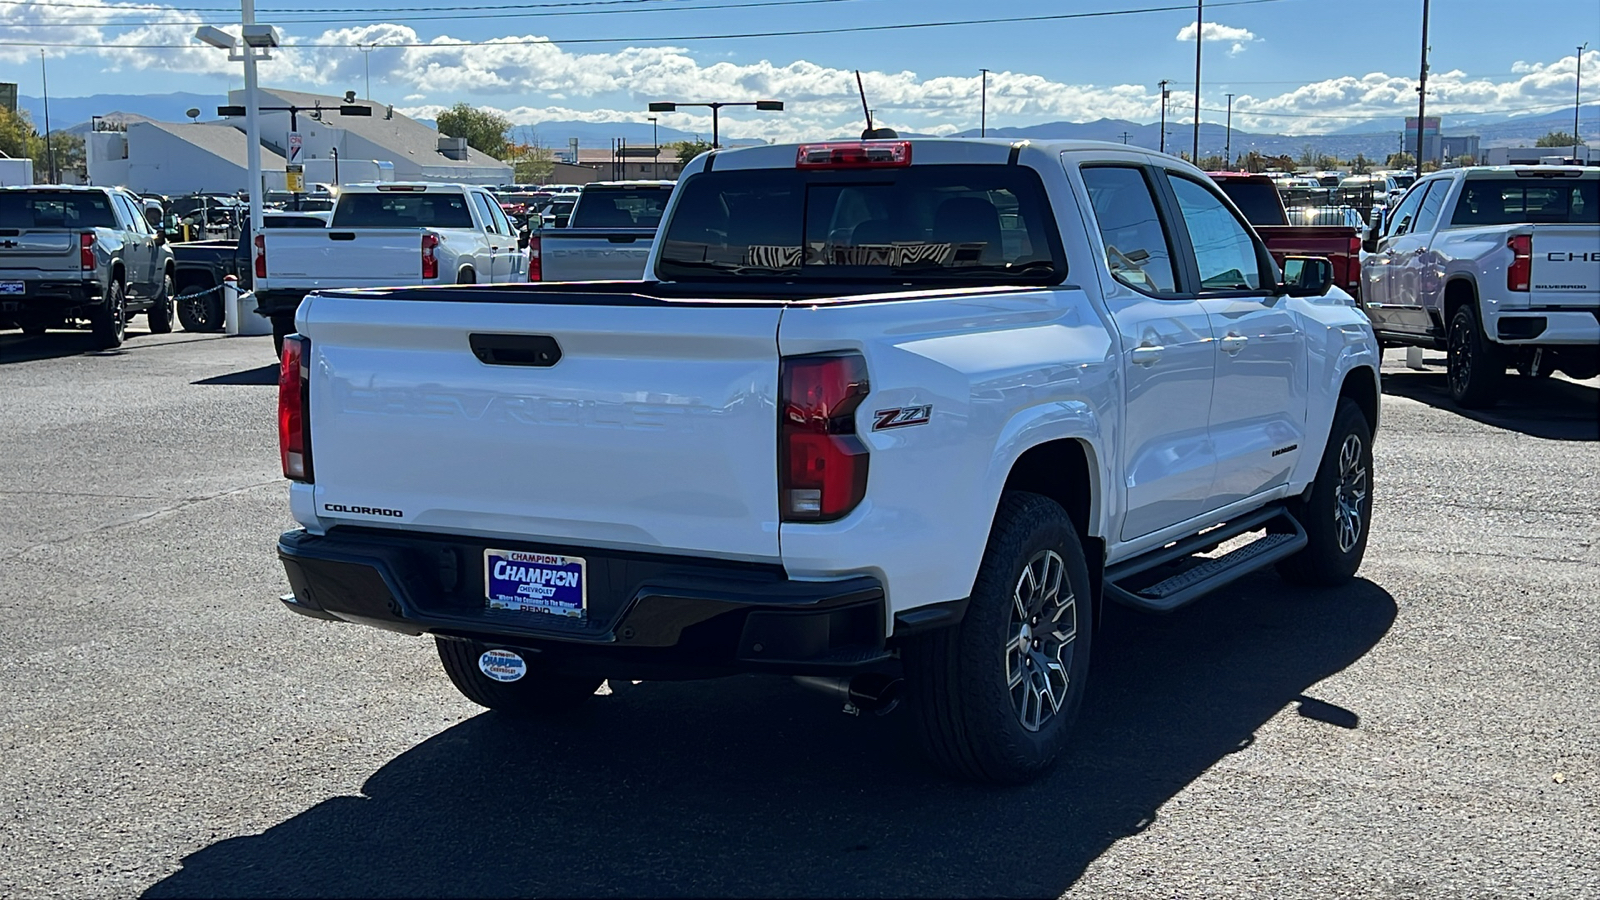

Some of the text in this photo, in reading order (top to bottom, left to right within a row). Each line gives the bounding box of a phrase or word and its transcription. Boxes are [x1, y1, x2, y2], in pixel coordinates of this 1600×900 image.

[342, 390, 710, 431] CEVROLET
[871, 404, 933, 433] Z71
[324, 503, 404, 518] COLORADO
[511, 552, 558, 565] CHAMPION
[493, 560, 579, 588] CHAMPION
[519, 585, 553, 595] CHEVROLET
[520, 605, 550, 614] RENO
